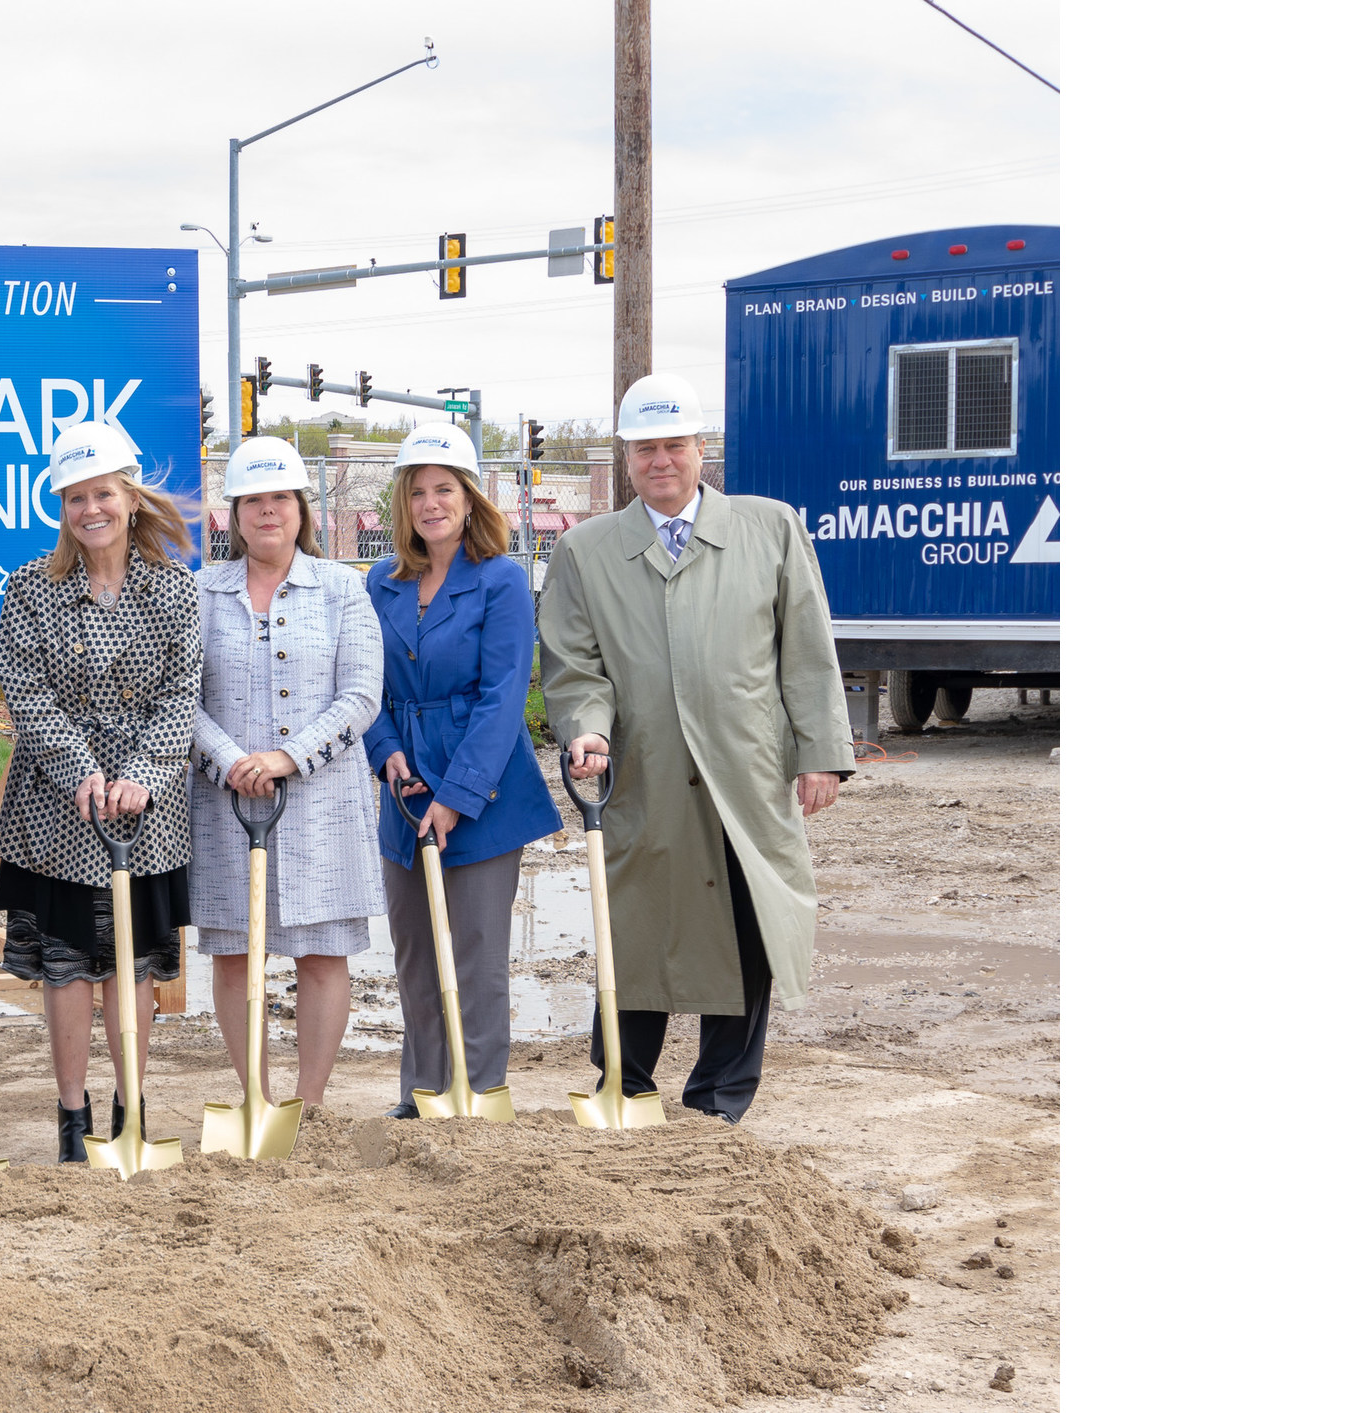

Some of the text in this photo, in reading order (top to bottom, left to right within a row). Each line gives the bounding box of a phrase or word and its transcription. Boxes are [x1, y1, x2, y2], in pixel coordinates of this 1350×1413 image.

[745, 281, 1054, 316] PLAN BRAND DESIGN BUILD PEOPLE
[639, 404, 670, 414] LaMACCHIA
[246, 461, 277, 471] LaMACCHIA
[839, 480, 867, 492] OUR
[873, 477, 943, 490] BUSINESS
[948, 476, 962, 488] IS
[968, 473, 1037, 487] BUILDING
[800, 501, 1010, 540] LaMACCHIA
[921, 542, 1009, 565] GROUP
